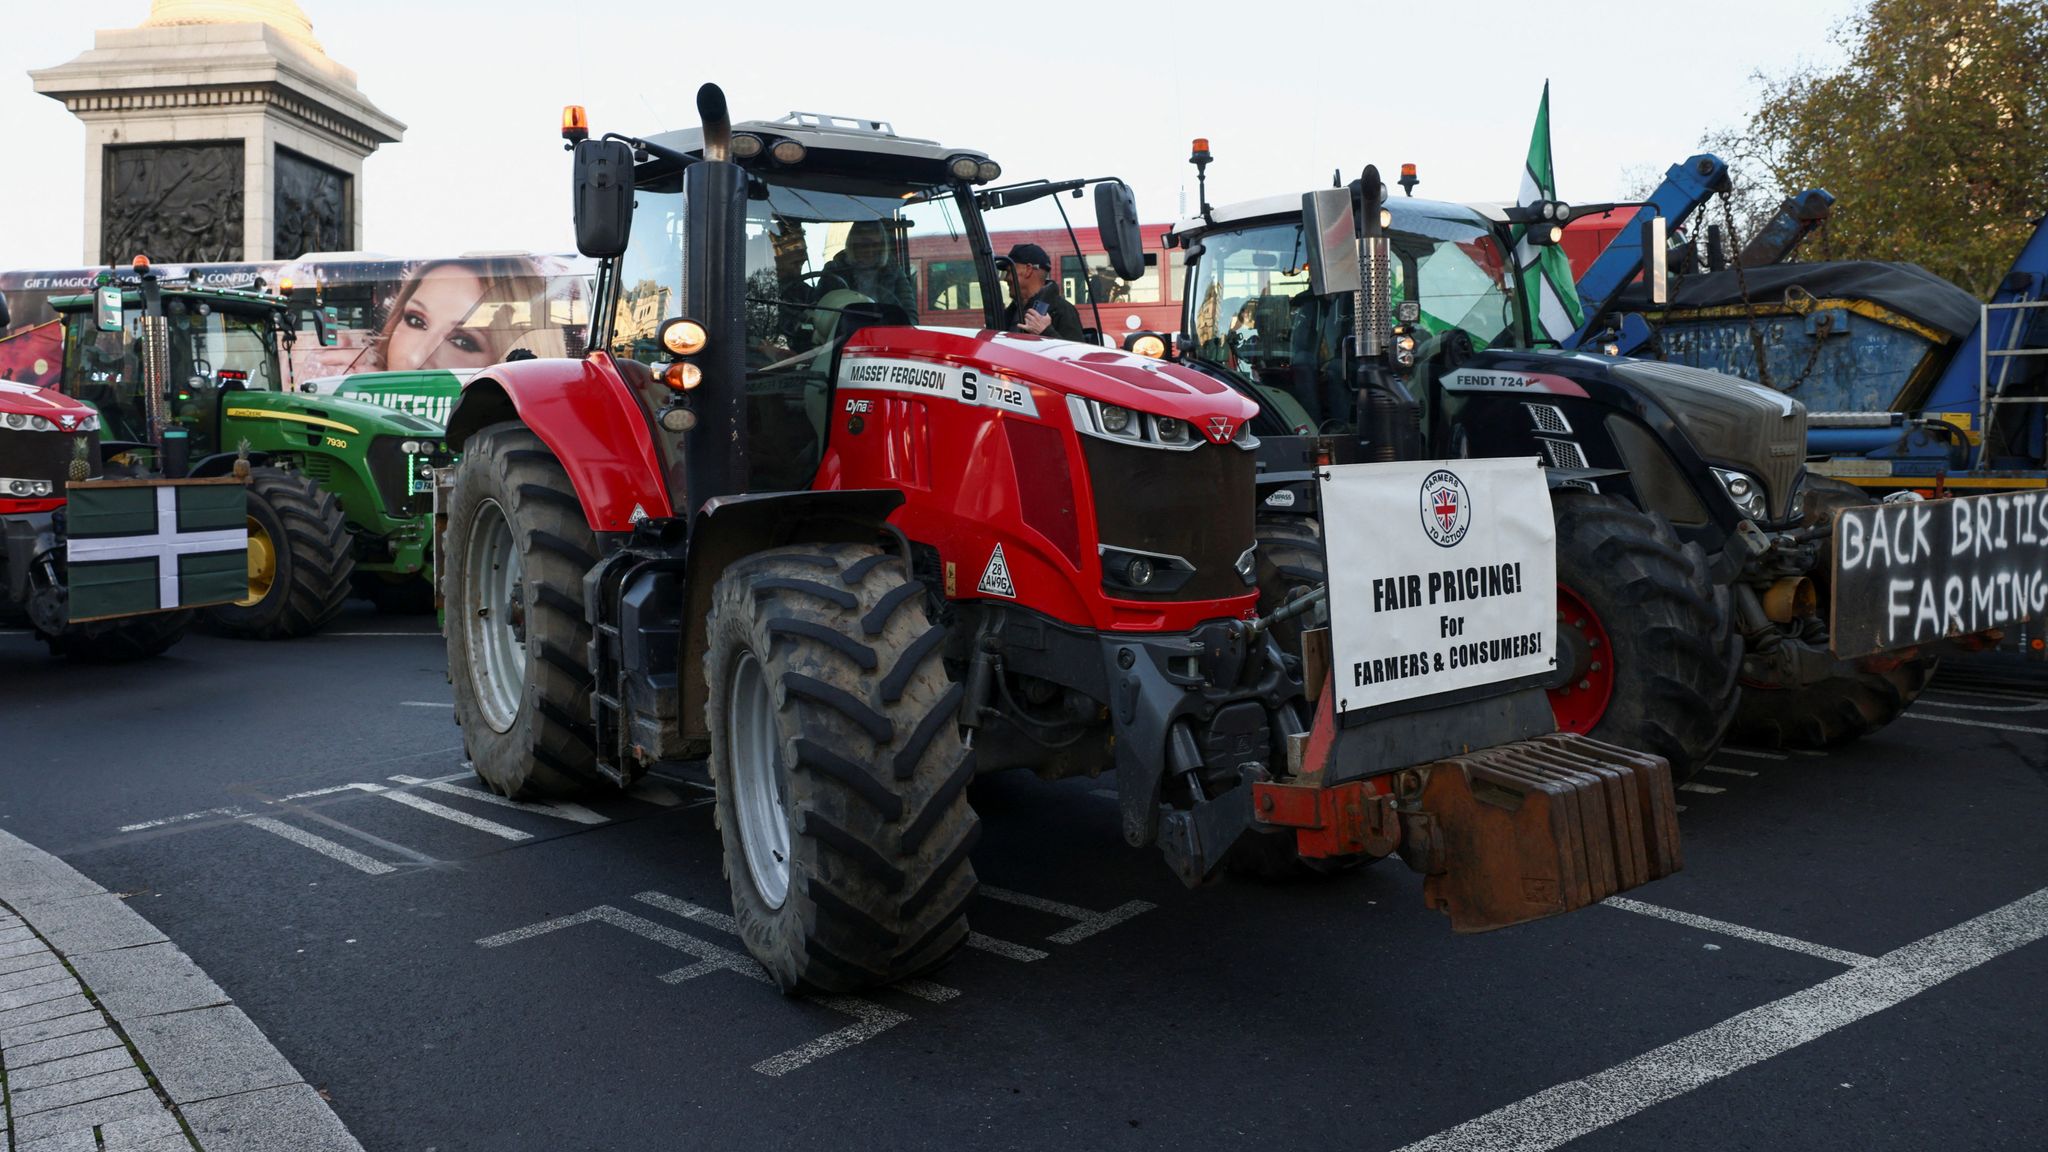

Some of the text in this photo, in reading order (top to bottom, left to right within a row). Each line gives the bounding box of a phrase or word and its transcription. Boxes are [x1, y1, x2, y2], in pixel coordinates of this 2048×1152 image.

[23, 278, 49, 289] GIFT
[207, 272, 264, 284] CONFIDE
[850, 365, 1023, 406] MASSEY FERGUSON S 7722
[1456, 375, 1496, 387] FENDT
[1500, 376, 1523, 388] 724
[326, 436, 347, 449] 7930
[1425, 473, 1459, 492] FARMERS
[1429, 525, 1465, 543] TO ACTION
[1841, 504, 1932, 570] BACK
[992, 563, 1002, 576] 28
[1372, 562, 1522, 613] FAIR PRICING!
[1887, 569, 2048, 642] FARMING
[1440, 616, 1465, 639] For
[1353, 632, 1542, 687] FARMERS & CONSUMERS!
